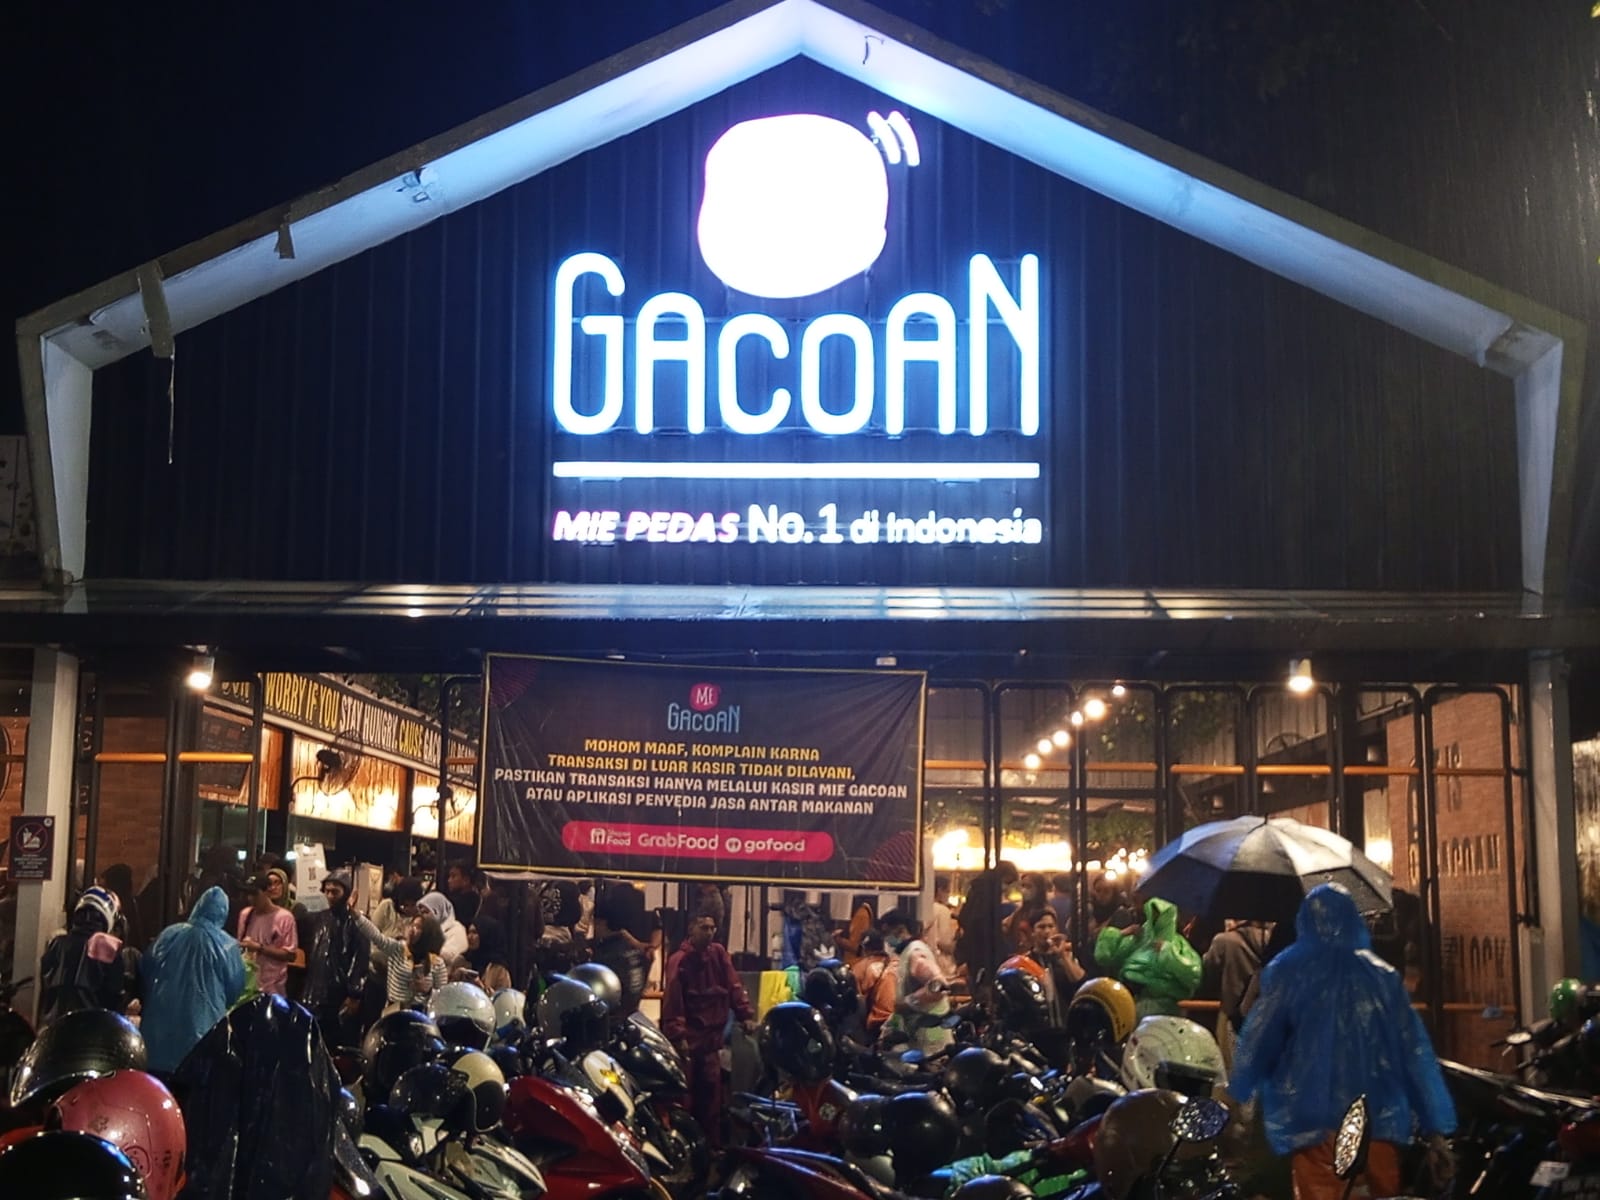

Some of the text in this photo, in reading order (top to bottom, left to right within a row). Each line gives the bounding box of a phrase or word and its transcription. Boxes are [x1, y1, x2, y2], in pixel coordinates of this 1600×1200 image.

[552, 251, 1041, 437] GACOAN
[552, 510, 618, 542] MIE
[625, 510, 740, 543] PEDAS
[850, 510, 880, 544] di
[886, 507, 1042, 544] Indonesia
[265, 672, 307, 718] WORRY
[305, 680, 319, 722] IF
[319, 684, 340, 731] YOU
[340, 694, 364, 738] STAY
[584, 739, 820, 761] MOHOM MAAF, KOMPLAIN KARNA
[548, 754, 856, 781] TRANSAKSI DI LUAR KASIR TIDAK DILAYANI,
[494, 768, 908, 799] PASTIKAN TRANSAKSI HANYA MELALUI KASIR MIE GACOAN
[526, 787, 874, 815] ATAU APLIKASI PENYEDIA JASA ANTAR MAKANAN
[637, 833, 719, 851] GrabFood
[744, 840, 806, 854] gofood
